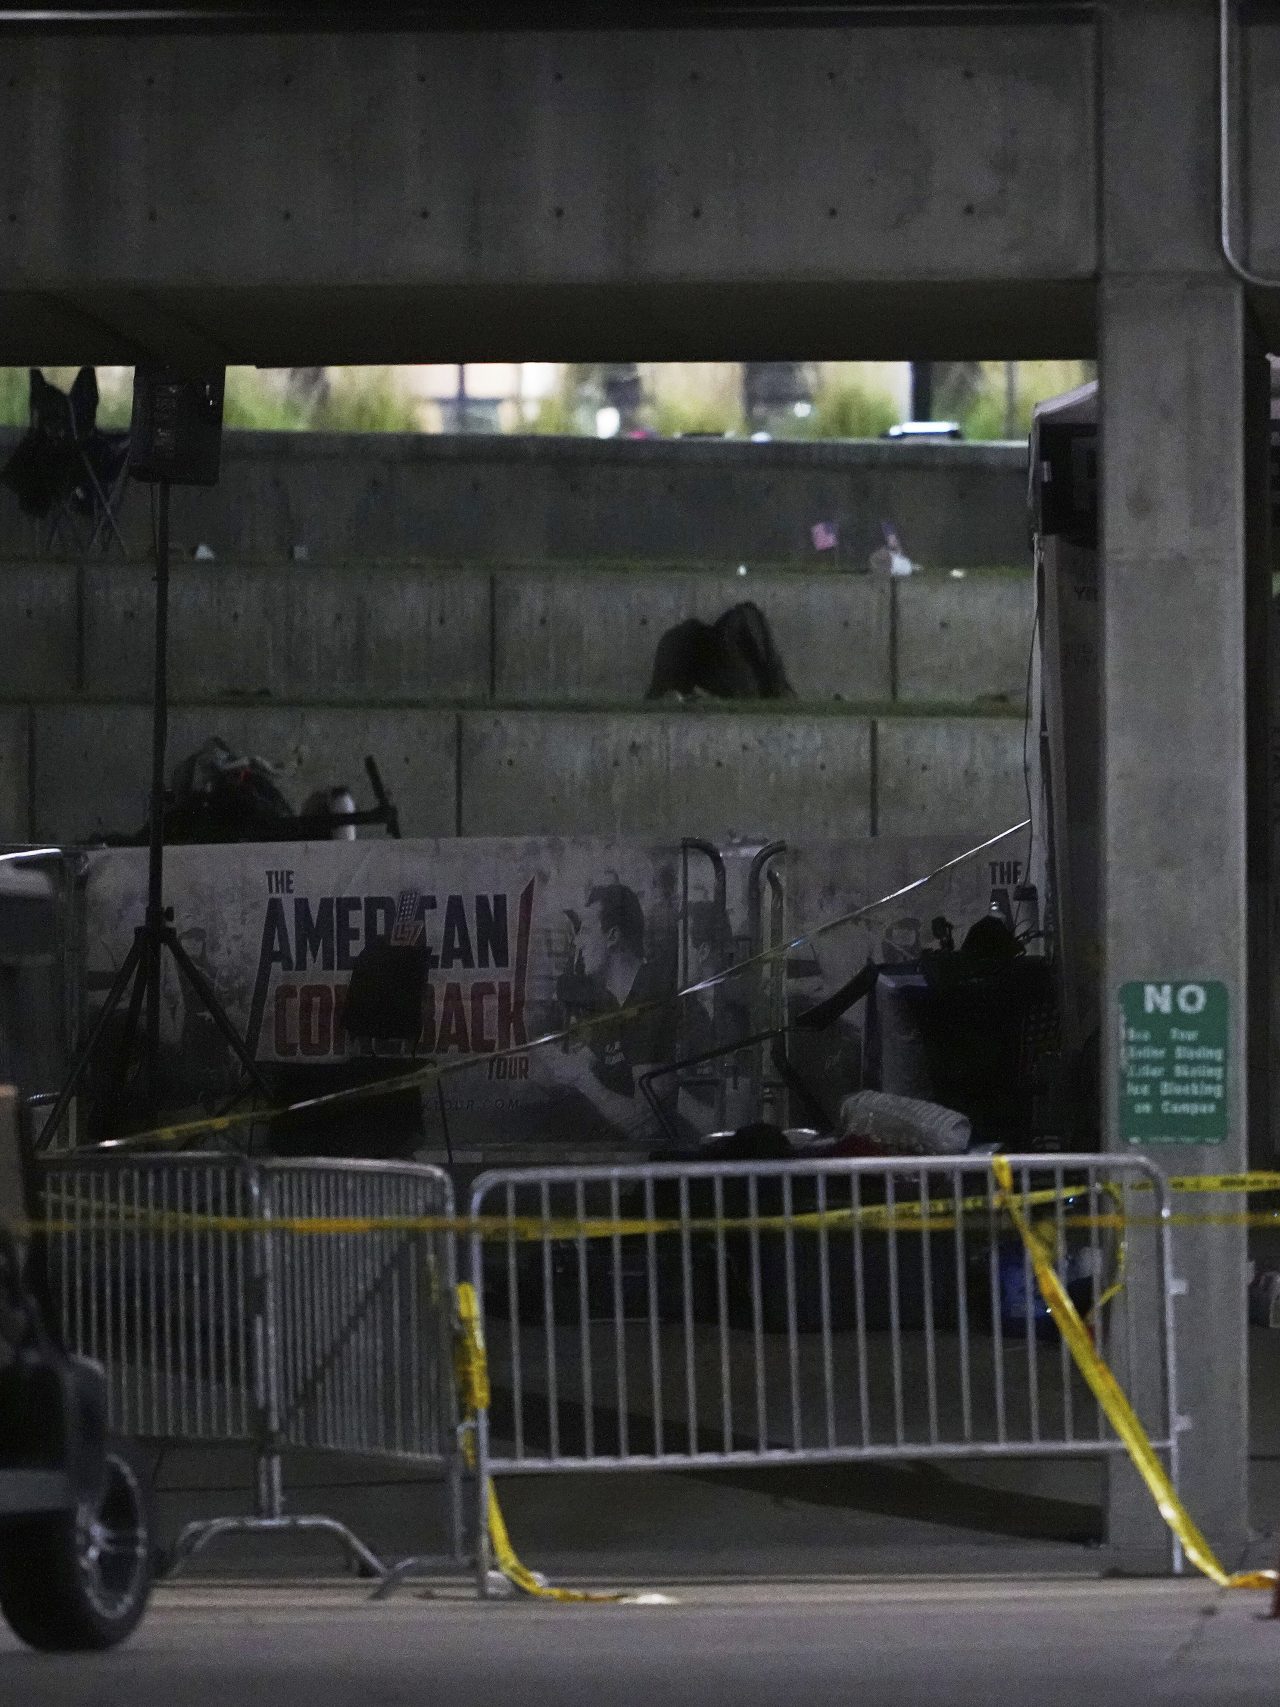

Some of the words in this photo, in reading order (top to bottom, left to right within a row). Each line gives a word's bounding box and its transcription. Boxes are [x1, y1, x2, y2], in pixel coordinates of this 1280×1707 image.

[265, 870, 295, 893] THE
[1144, 984, 1207, 1014] NO
[487, 1057, 529, 1080] TOUR
